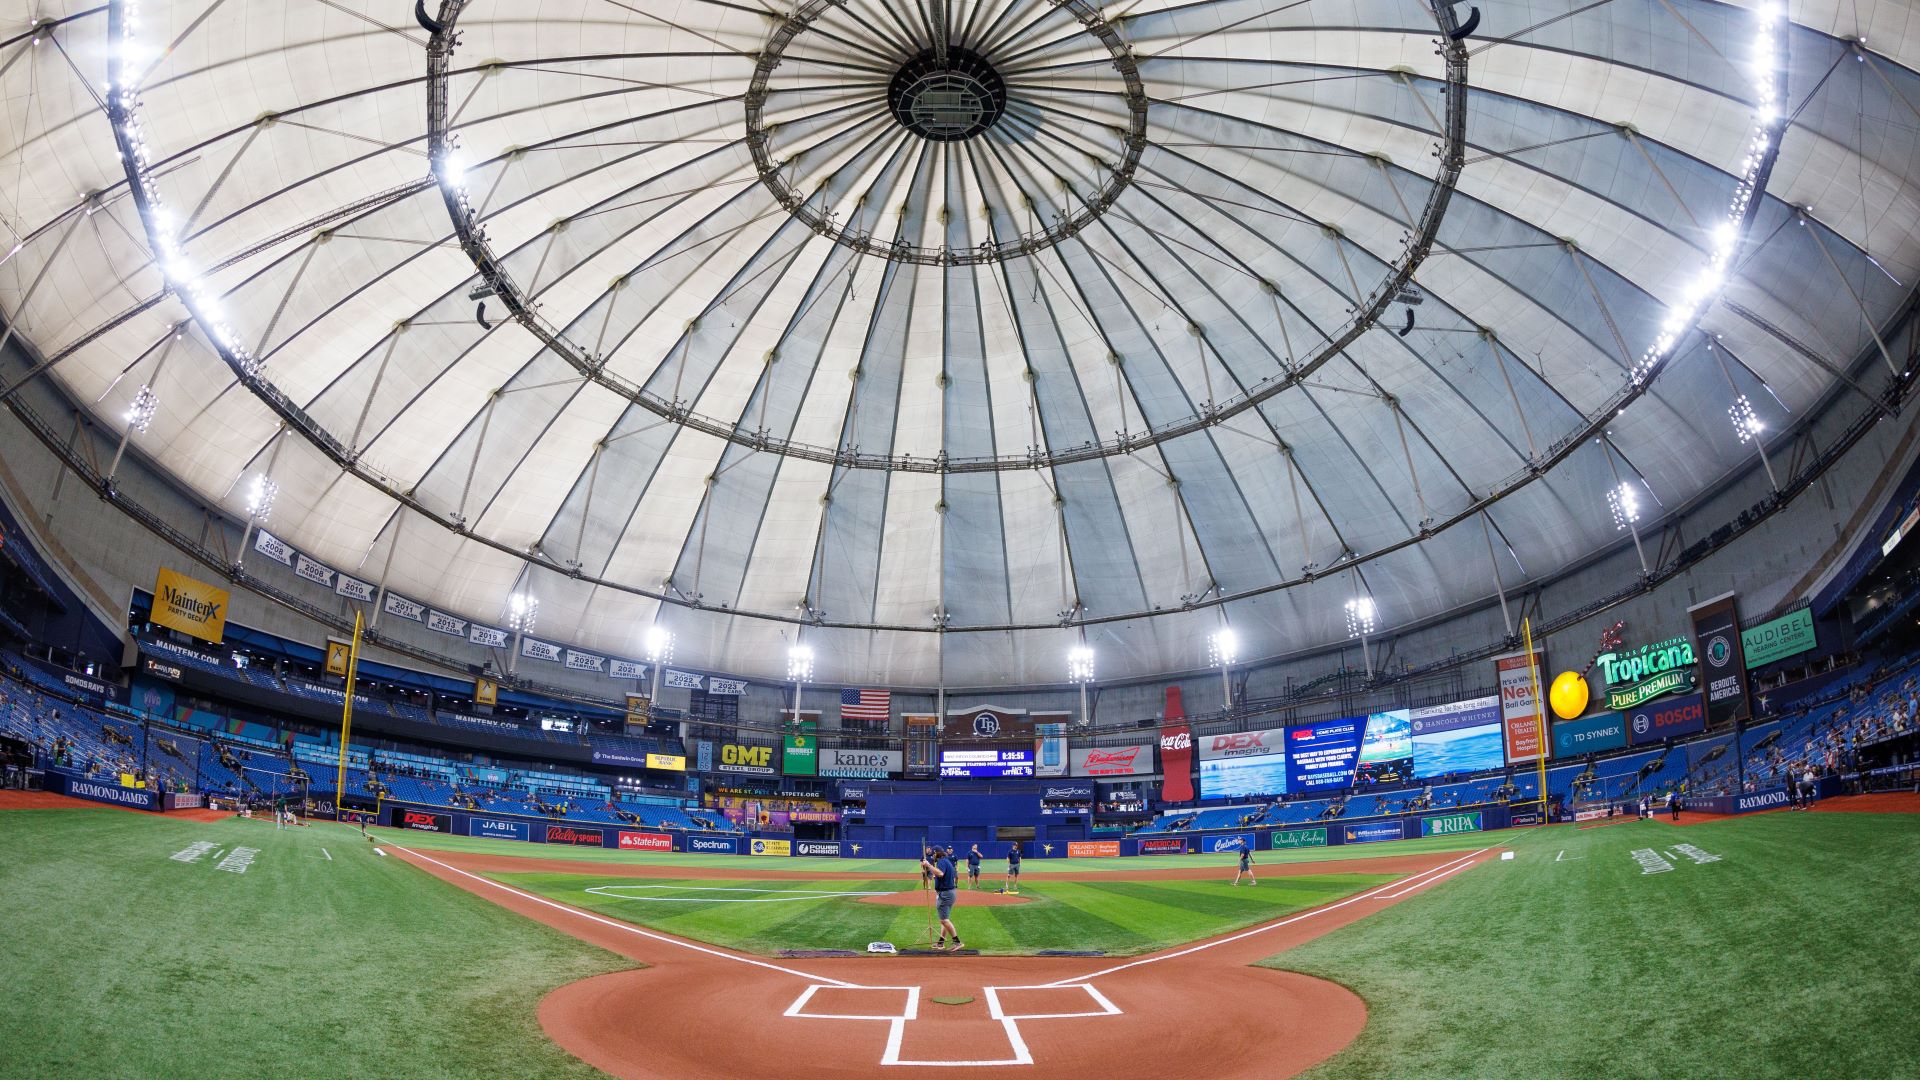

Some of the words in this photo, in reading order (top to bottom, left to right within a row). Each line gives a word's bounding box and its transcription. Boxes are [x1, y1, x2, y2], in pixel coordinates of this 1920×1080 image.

[258, 544, 287, 563] CHAMPIONS
[264, 540, 284, 556] 2008
[298, 568, 328, 585] CHAMPIONS
[304, 564, 324, 578] 2008
[344, 582, 364, 594] 2010
[162, 585, 221, 624] MaintenX
[395, 602, 414, 614] 2011
[168, 606, 187, 617] PARTY
[188, 612, 203, 623] DECK
[388, 606, 402, 614] WILD
[402, 610, 418, 620] CARD
[431, 622, 445, 630] WILD
[445, 626, 461, 635] CARD
[437, 618, 456, 628] 2013
[478, 631, 498, 641] 2019
[1744, 616, 1812, 648] AUDIBEL
[531, 645, 550, 655] 2020
[1619, 650, 1637, 659] THE
[1650, 636, 1687, 650] ORIGINAL
[1753, 641, 1778, 654] HEARING
[1780, 631, 1805, 645] CENTERS
[156, 640, 220, 666] MAINTENX.COM
[574, 656, 595, 666] 2020
[568, 662, 600, 671] CHAMPIONS
[618, 666, 636, 674] 2021
[1597, 643, 1694, 684] Tropicana
[65, 674, 88, 689] SOMOS
[88, 682, 105, 694] RAYS
[674, 675, 694, 684] 2022
[1710, 675, 1737, 692] REROUTE
[1504, 684, 1539, 700] New
[1611, 690, 1638, 707] PURE
[1639, 672, 1684, 699] PREMIUM
[1710, 685, 1740, 702] AMERICAS
[144, 692, 161, 706] VIVA
[1505, 700, 1519, 709] Ball
[1426, 717, 1459, 728] HANCOCK
[1461, 711, 1496, 722] WHITNEY
[1655, 704, 1702, 727] BOSCH
[978, 717, 995, 733] TB
[1212, 732, 1266, 751] DEX
[1516, 737, 1538, 746] Bayfront
[1574, 734, 1585, 742] TD
[1586, 726, 1620, 740] SYNNEX
[722, 744, 773, 766] GMF
[834, 751, 888, 767] kane's
[1089, 751, 1134, 763] Budweiser
[1224, 746, 1271, 756] imaging
[72, 781, 118, 800] RAYMOND
[119, 790, 148, 805] JAMES
[1739, 792, 1785, 809] RAYMOND
[317, 800, 332, 813] 162
[404, 812, 437, 825] DEX
[483, 822, 517, 831] JABIL
[1444, 816, 1474, 832] RIPA
[548, 827, 578, 845] Bally
[579, 834, 601, 842] SPORTS
[693, 839, 729, 849] Spectrum
[1274, 832, 1299, 845] Quality
[1300, 832, 1324, 844] Roofing
